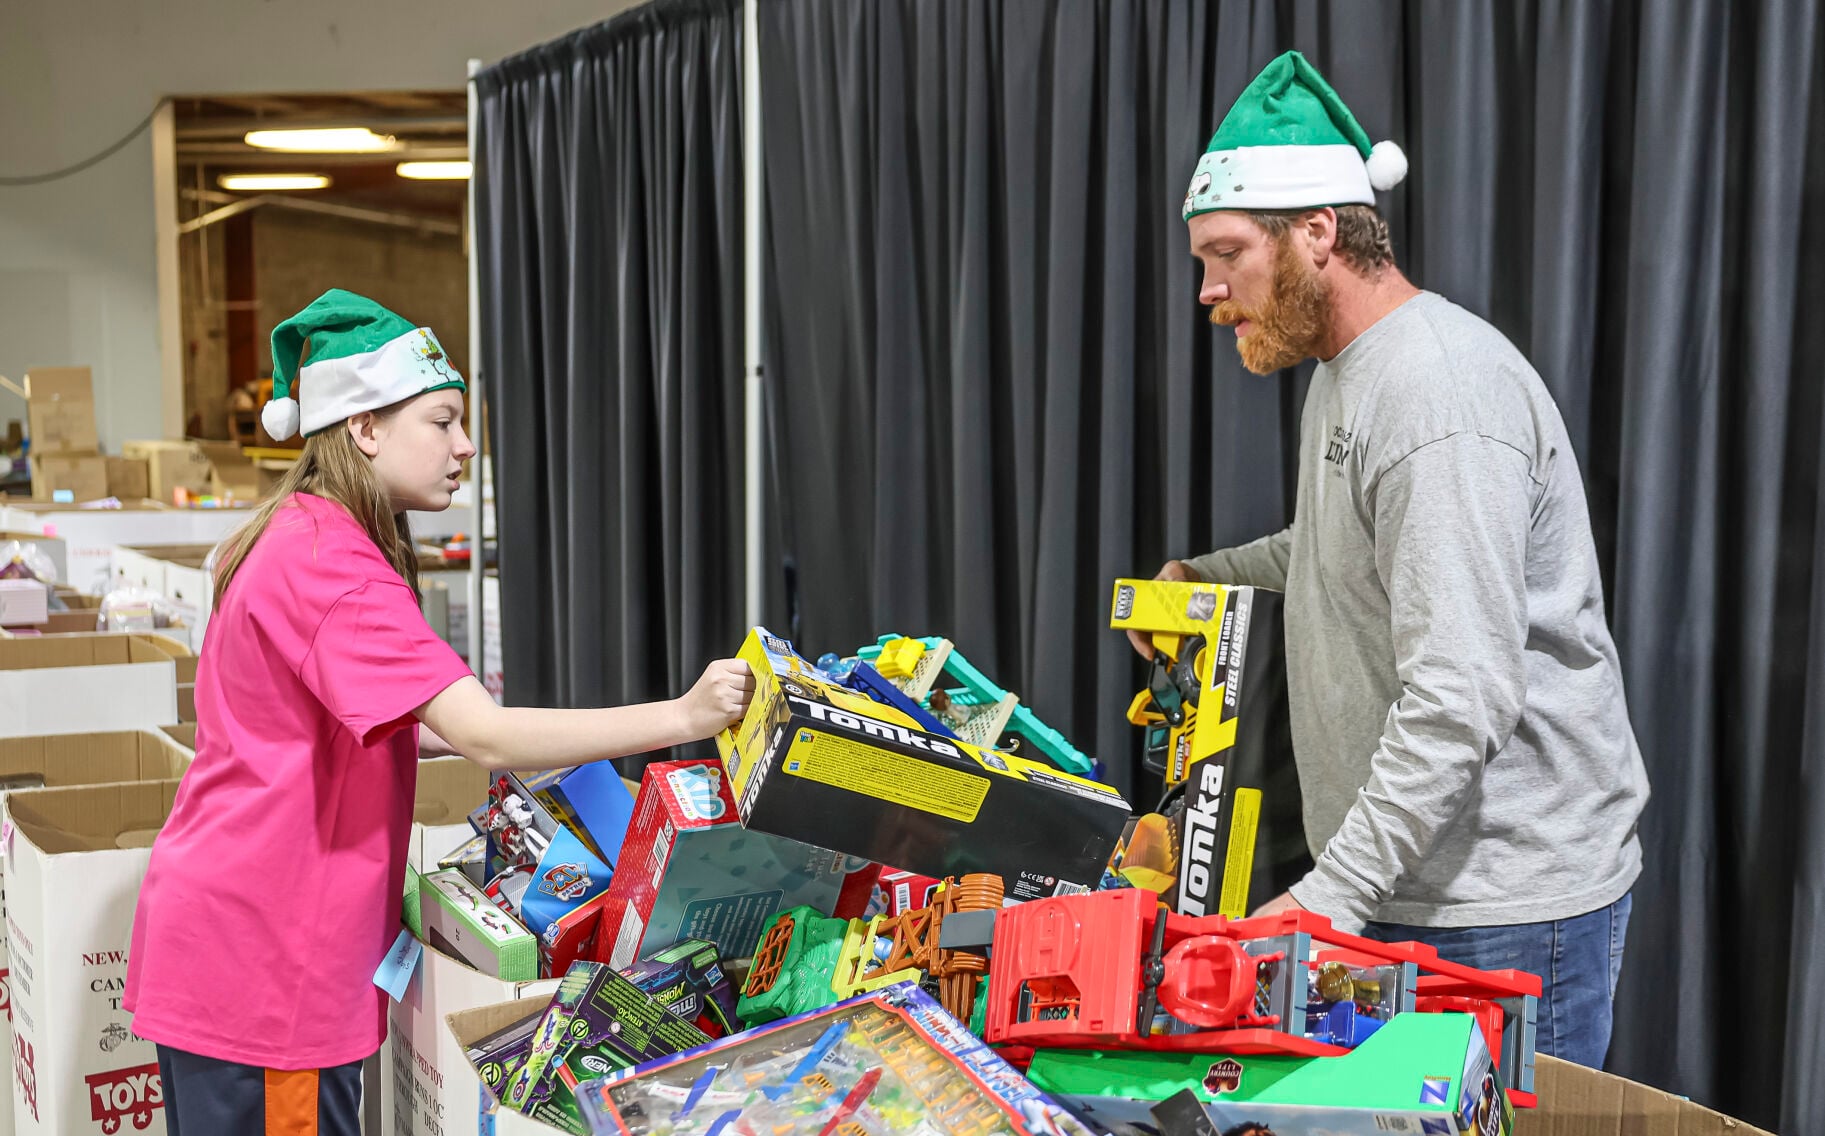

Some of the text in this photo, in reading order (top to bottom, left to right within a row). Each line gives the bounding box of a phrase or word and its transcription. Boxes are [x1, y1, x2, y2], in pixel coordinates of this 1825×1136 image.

[1217, 611, 1234, 666] FRONT LOADER
[1225, 602, 1248, 707] STEEL CLASSICS
[789, 694, 961, 759] Tonka
[741, 726, 783, 819] Tonka
[1176, 735, 1186, 781] Tonka
[1178, 763, 1224, 918] Tonka
[537, 862, 588, 897] PAW
[561, 881, 588, 897] PATROL
[82, 950, 128, 967] NEW,
[429, 1064, 444, 1090] TOY
[585, 1057, 613, 1074] NERF
[1210, 1070, 1240, 1078] COUNTRY
[94, 1072, 163, 1112] TOYS
